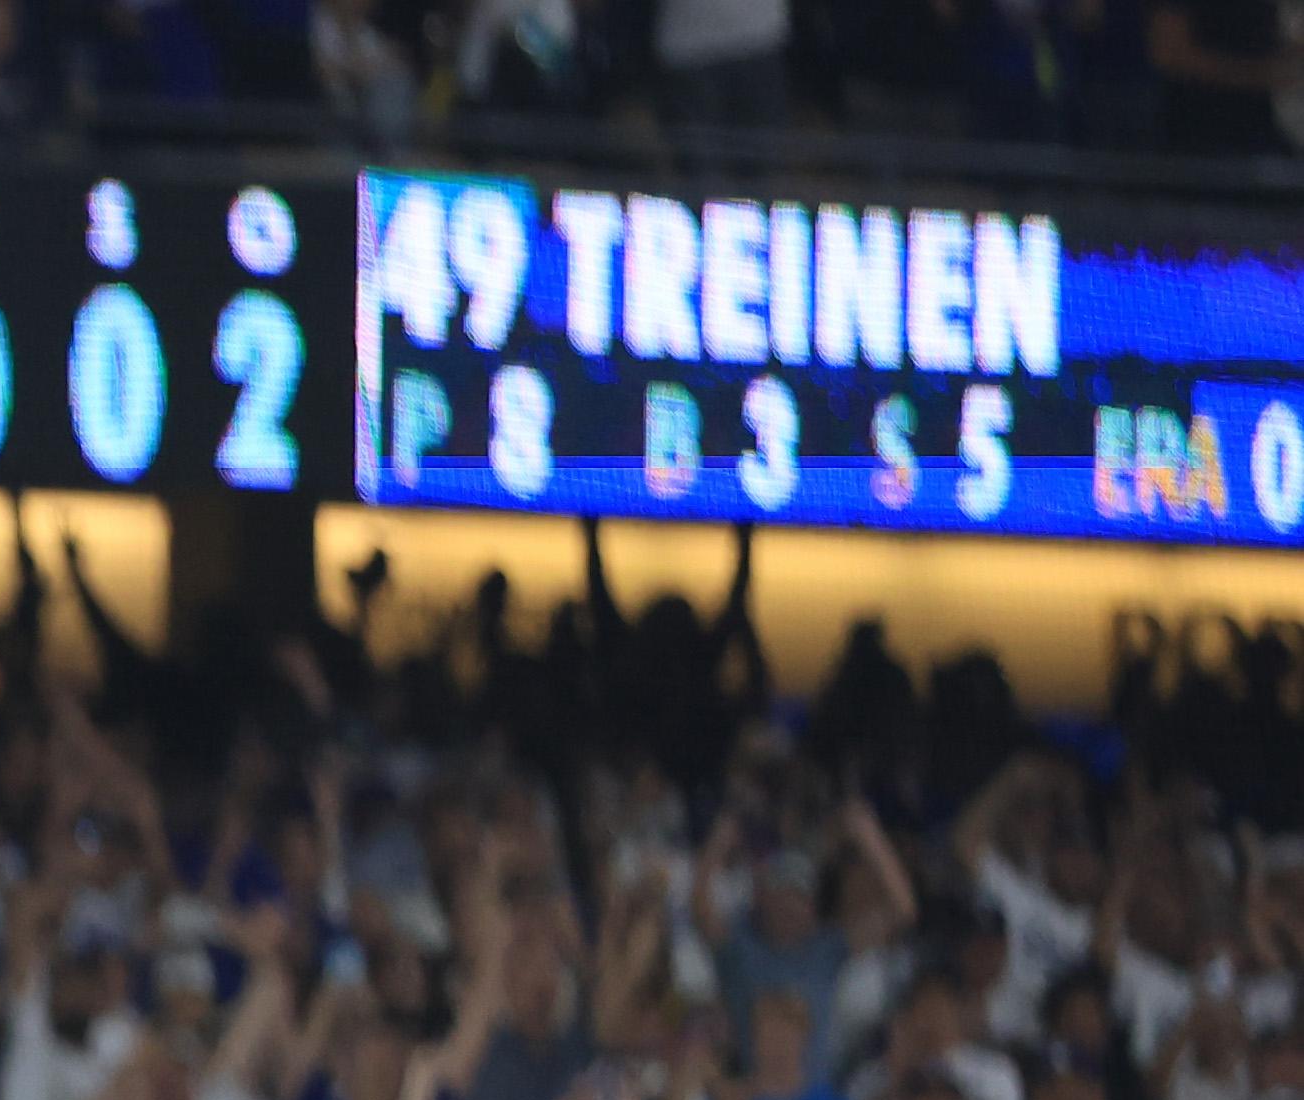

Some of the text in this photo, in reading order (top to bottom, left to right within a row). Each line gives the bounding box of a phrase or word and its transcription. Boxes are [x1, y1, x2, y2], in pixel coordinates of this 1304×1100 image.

[381, 182, 1062, 378] 49 TREINEN
[69, 282, 167, 484] 0
[214, 288, 305, 491] 2
[393, 369, 452, 489] P
[489, 364, 554, 498] 8
[738, 374, 799, 511] 3
[871, 395, 918, 510] S
[956, 384, 1013, 521] 5
[1093, 405, 1229, 520] ERA
